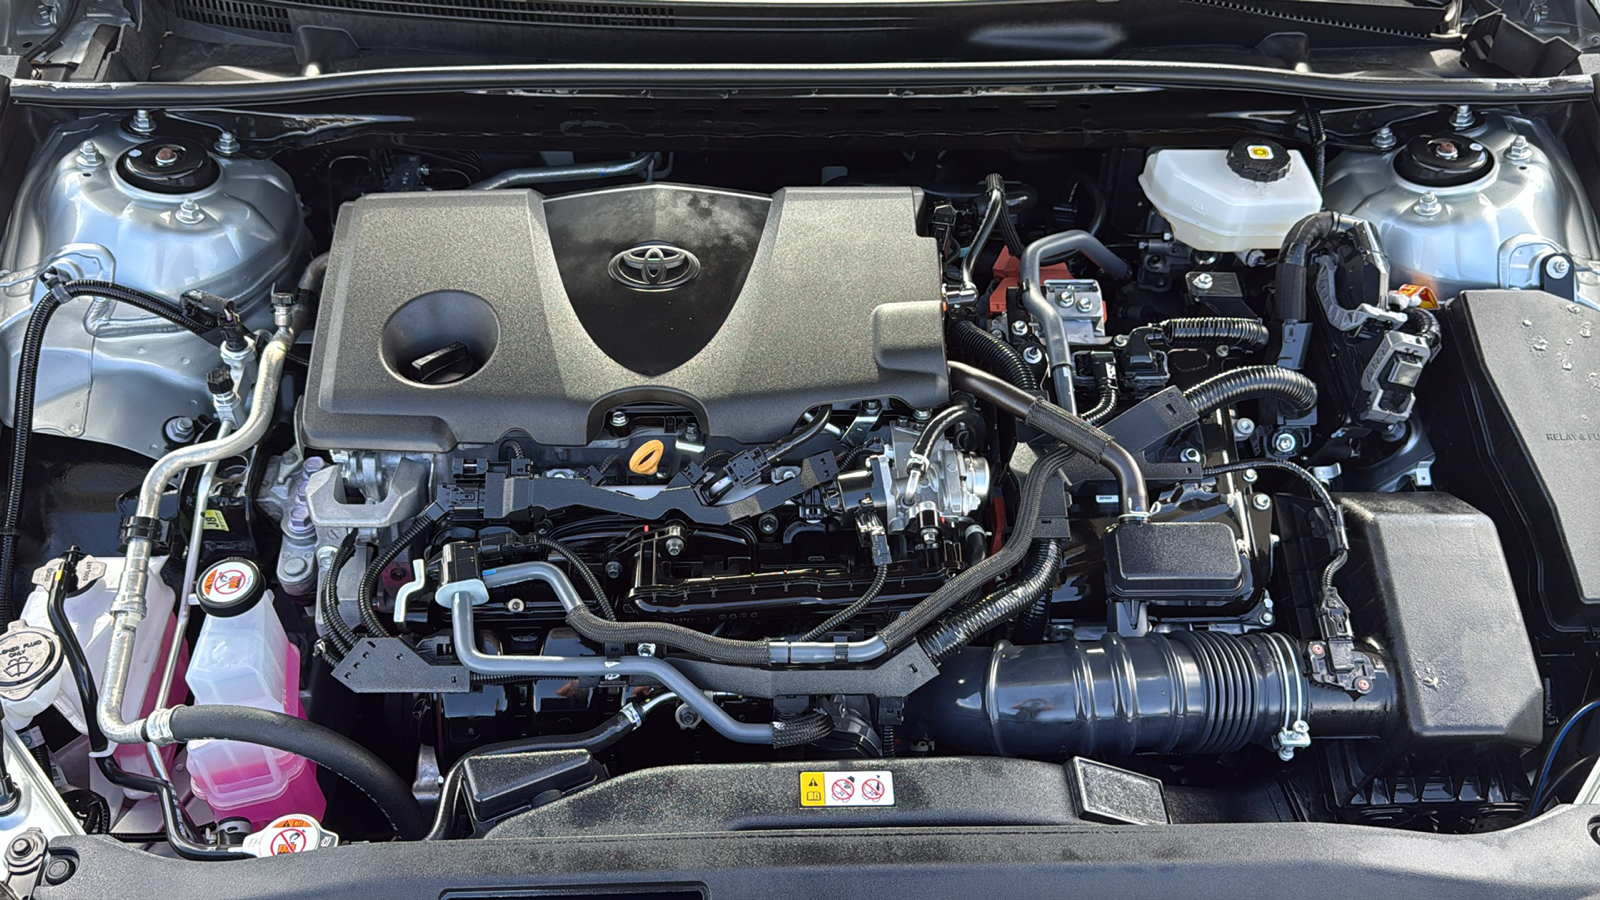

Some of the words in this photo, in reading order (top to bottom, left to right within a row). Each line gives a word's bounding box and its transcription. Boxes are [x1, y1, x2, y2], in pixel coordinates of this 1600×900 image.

[1545, 432, 1577, 441] RELAY
[1579, 433, 1586, 441] &
[0, 645, 20, 655] SHER
[23, 639, 42, 649] FLUID
[9, 650, 26, 658] ONLY
